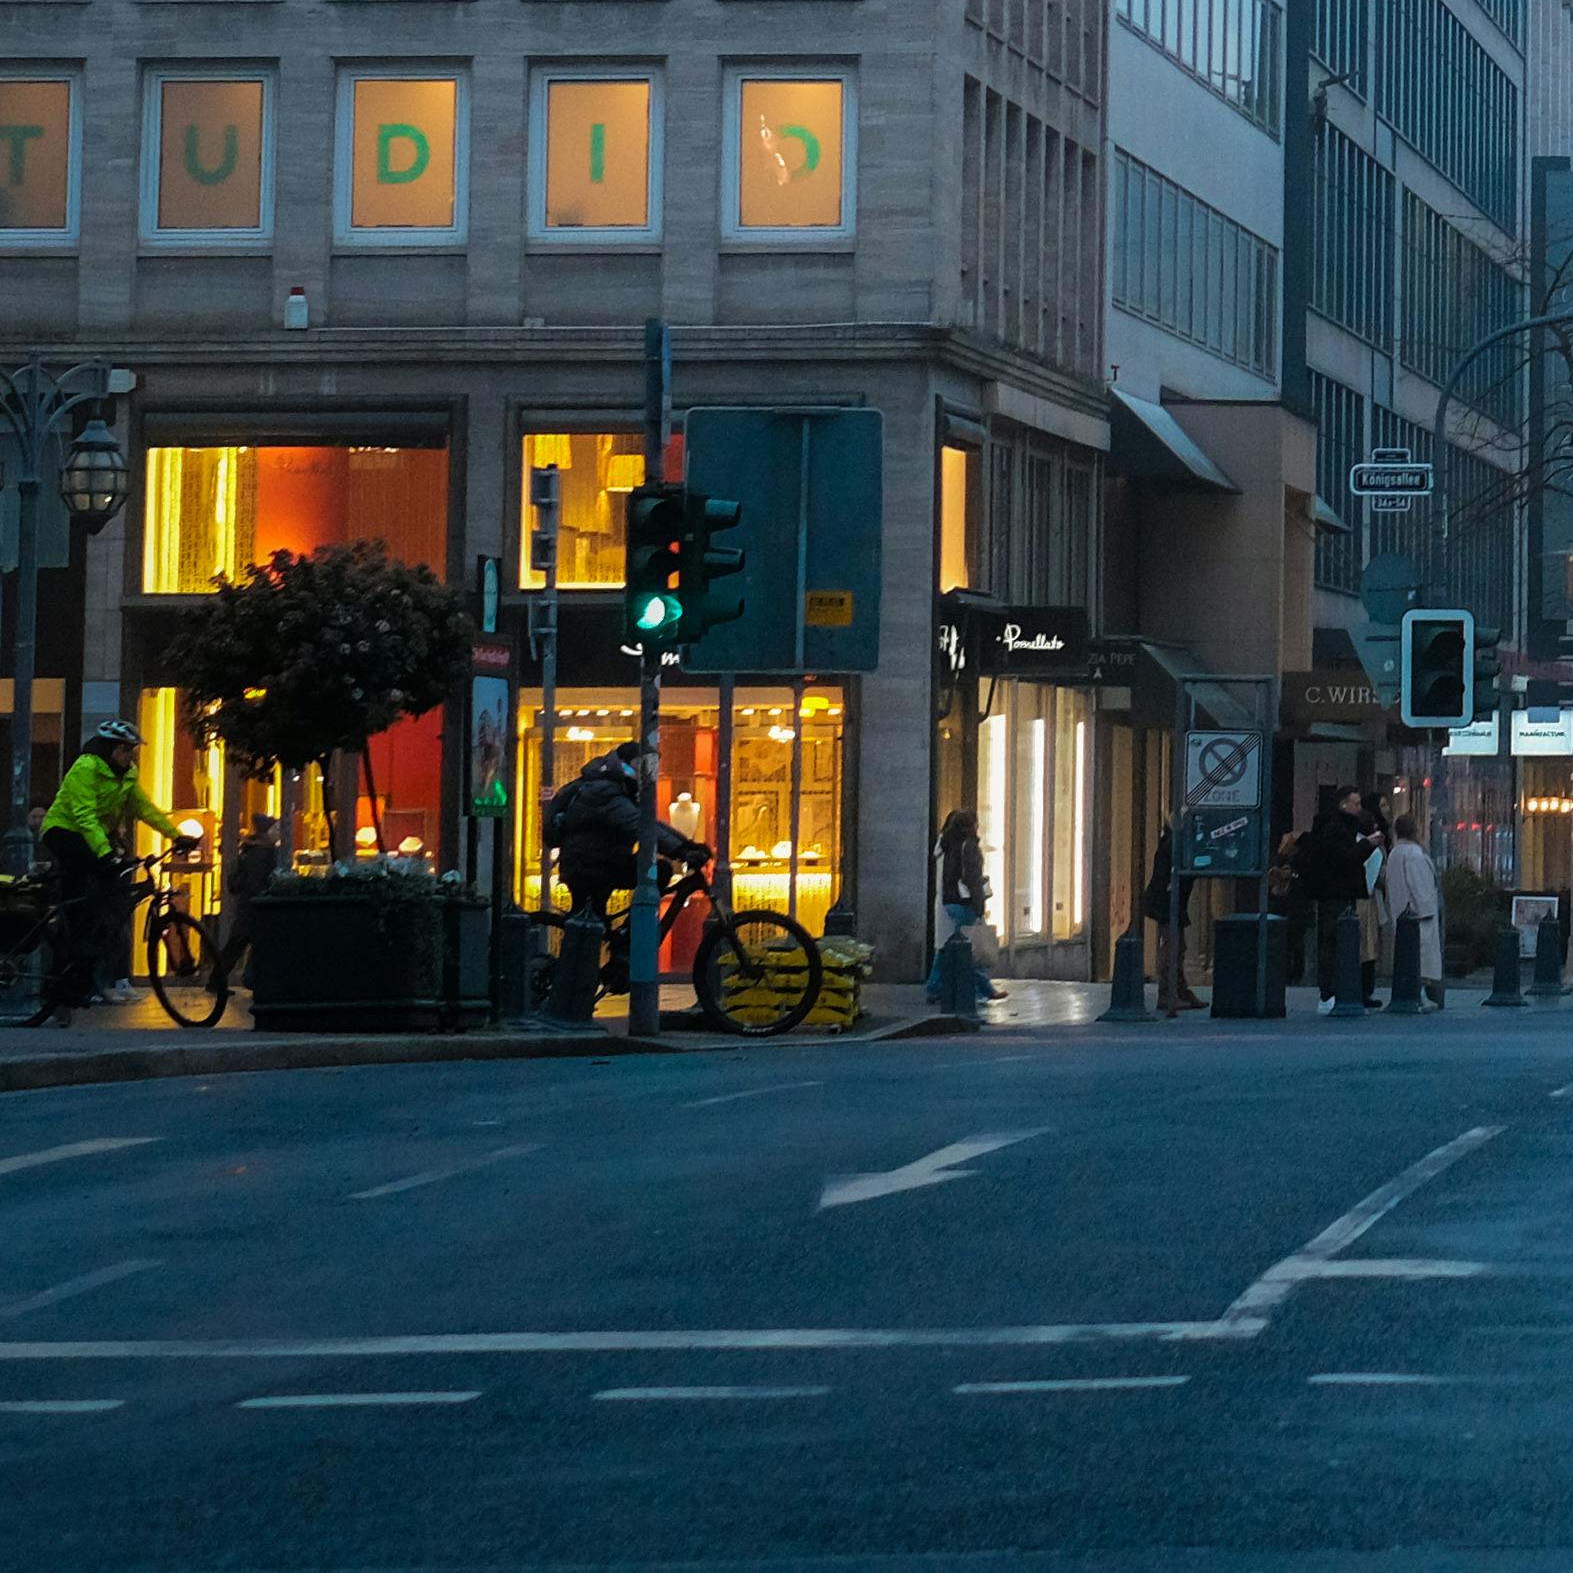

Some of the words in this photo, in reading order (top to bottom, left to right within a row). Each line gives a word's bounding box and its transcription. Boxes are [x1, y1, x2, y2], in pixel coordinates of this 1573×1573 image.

[1361, 471, 1421, 488] Königsallee
[1002, 623, 1065, 652] Pomellato
[1109, 652, 1136, 665] PEPE
